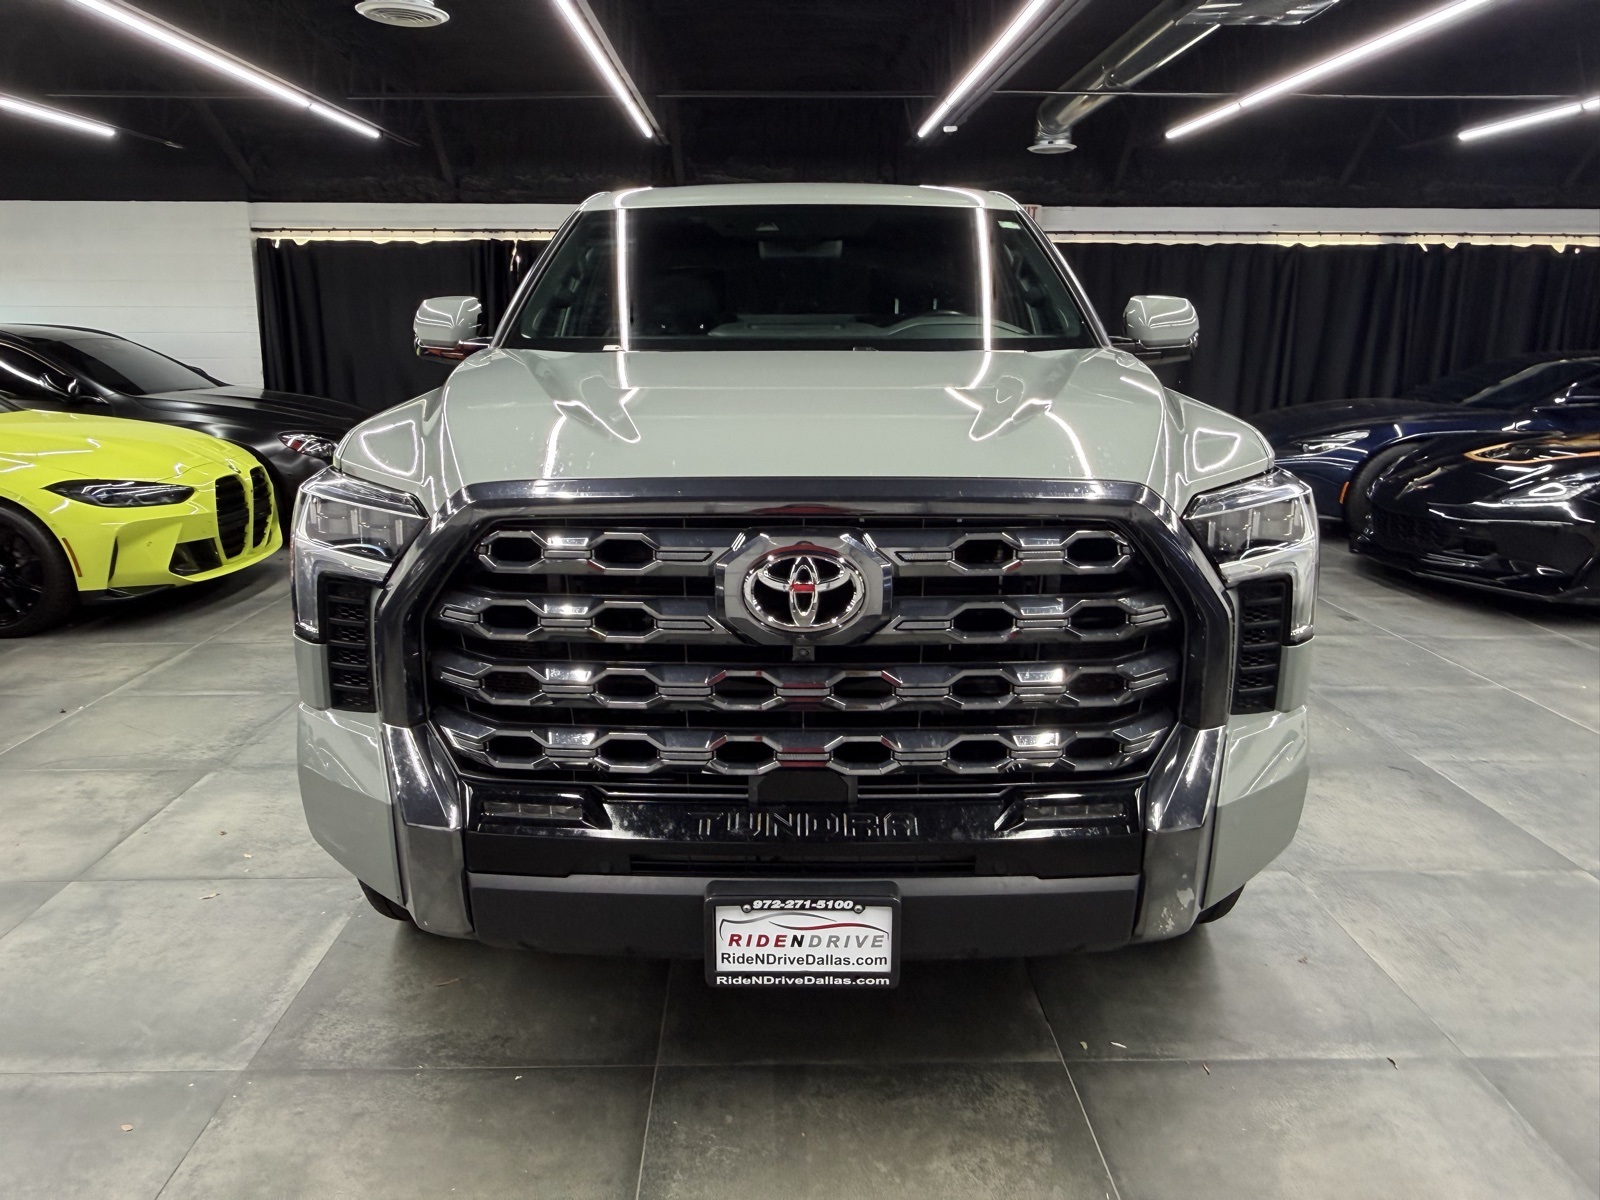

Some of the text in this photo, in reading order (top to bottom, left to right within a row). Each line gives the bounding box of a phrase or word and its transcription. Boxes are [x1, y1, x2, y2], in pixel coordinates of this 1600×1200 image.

[688, 812, 919, 837] TUNDRA
[752, 900, 854, 910] 972-271-5100
[728, 933, 885, 949] RIDENDRIVE
[721, 952, 888, 966] RideNDriveDallas.com
[716, 975, 890, 985] RideNDriveDallas.com
